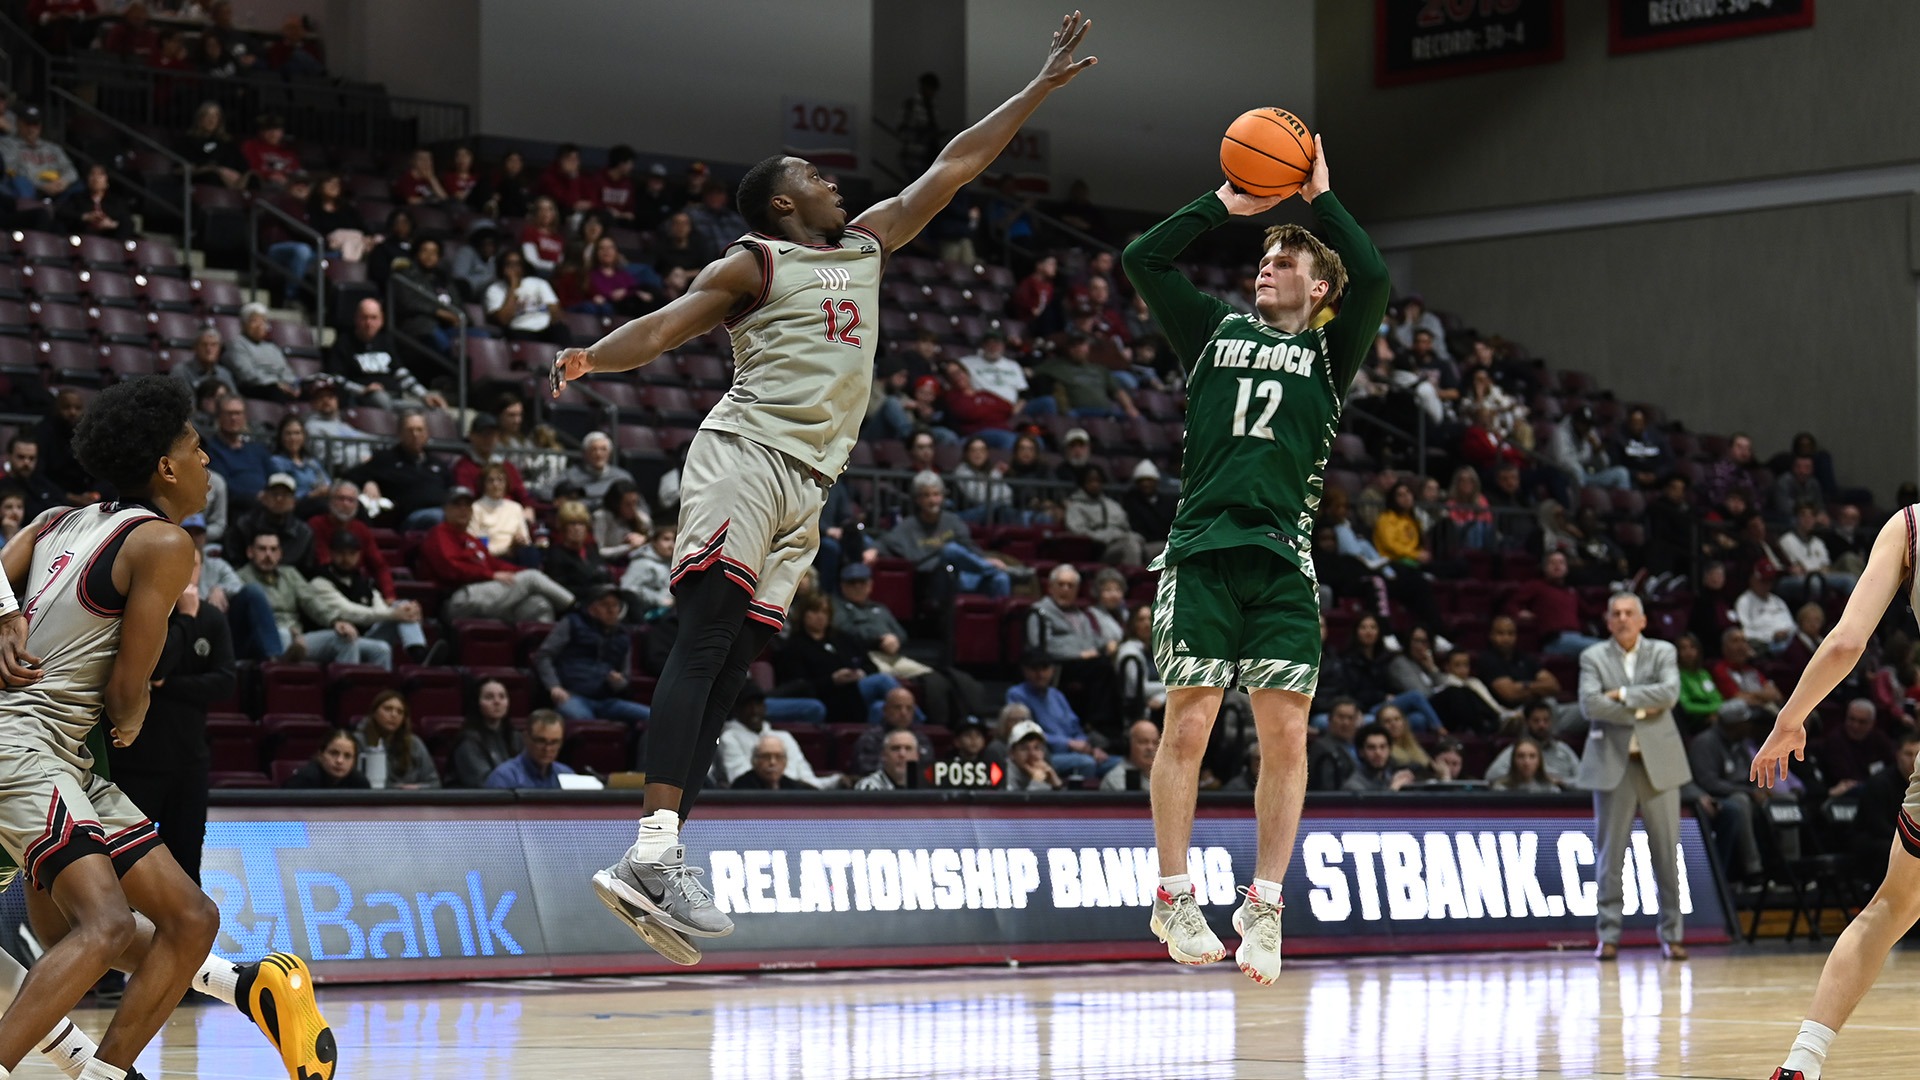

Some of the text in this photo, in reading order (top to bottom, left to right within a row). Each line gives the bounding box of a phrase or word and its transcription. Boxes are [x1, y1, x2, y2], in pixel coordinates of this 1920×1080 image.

[1411, 28, 1482, 61] RECORD:
[792, 103, 849, 136] 102
[1007, 134, 1042, 161] 01
[813, 267, 851, 291] IUP
[820, 297, 861, 349] 12
[1213, 338, 1317, 378] THE ROCK
[1232, 377, 1284, 441] 12
[709, 846, 1238, 914] RELATIONSHIP BANKNG
[294, 869, 526, 961] Bank
